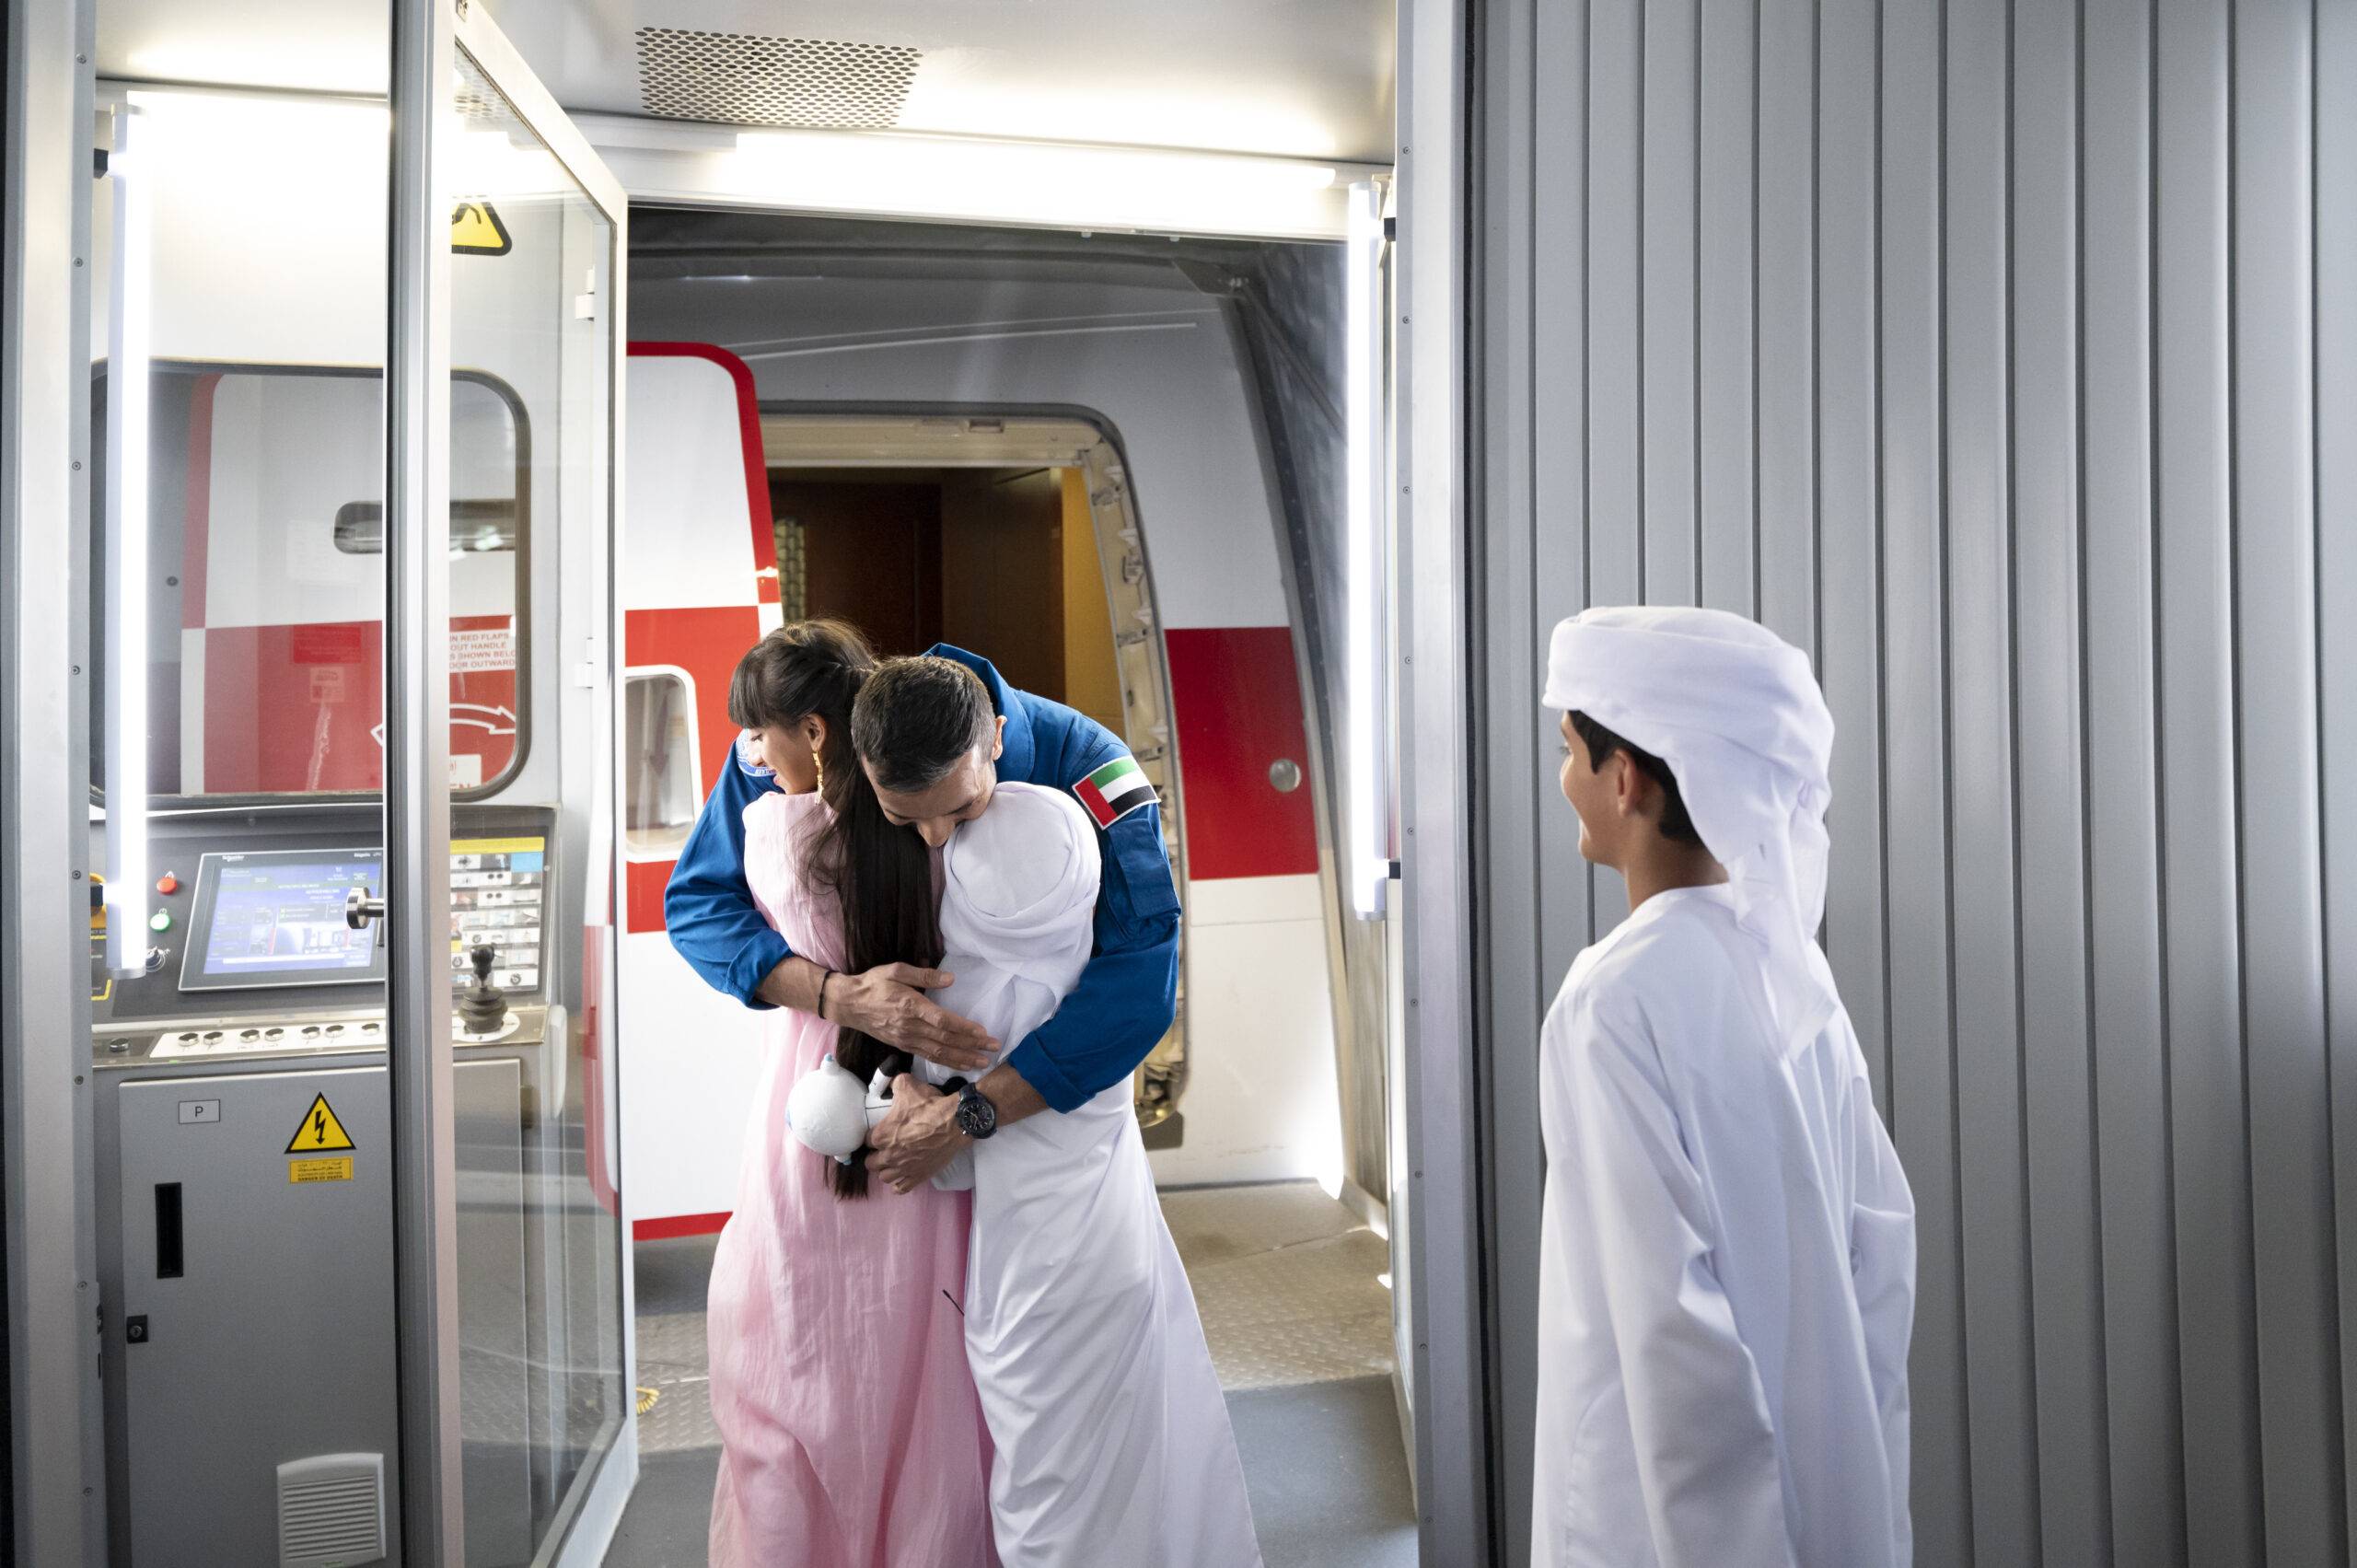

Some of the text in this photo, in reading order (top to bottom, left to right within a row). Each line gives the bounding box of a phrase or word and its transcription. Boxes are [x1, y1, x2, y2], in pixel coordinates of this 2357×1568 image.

[460, 633, 478, 642] RED
[481, 633, 509, 641] FLAPS
[458, 651, 491, 659] SHOWN
[493, 649, 516, 657] BELO
[195, 1106, 203, 1117] P
